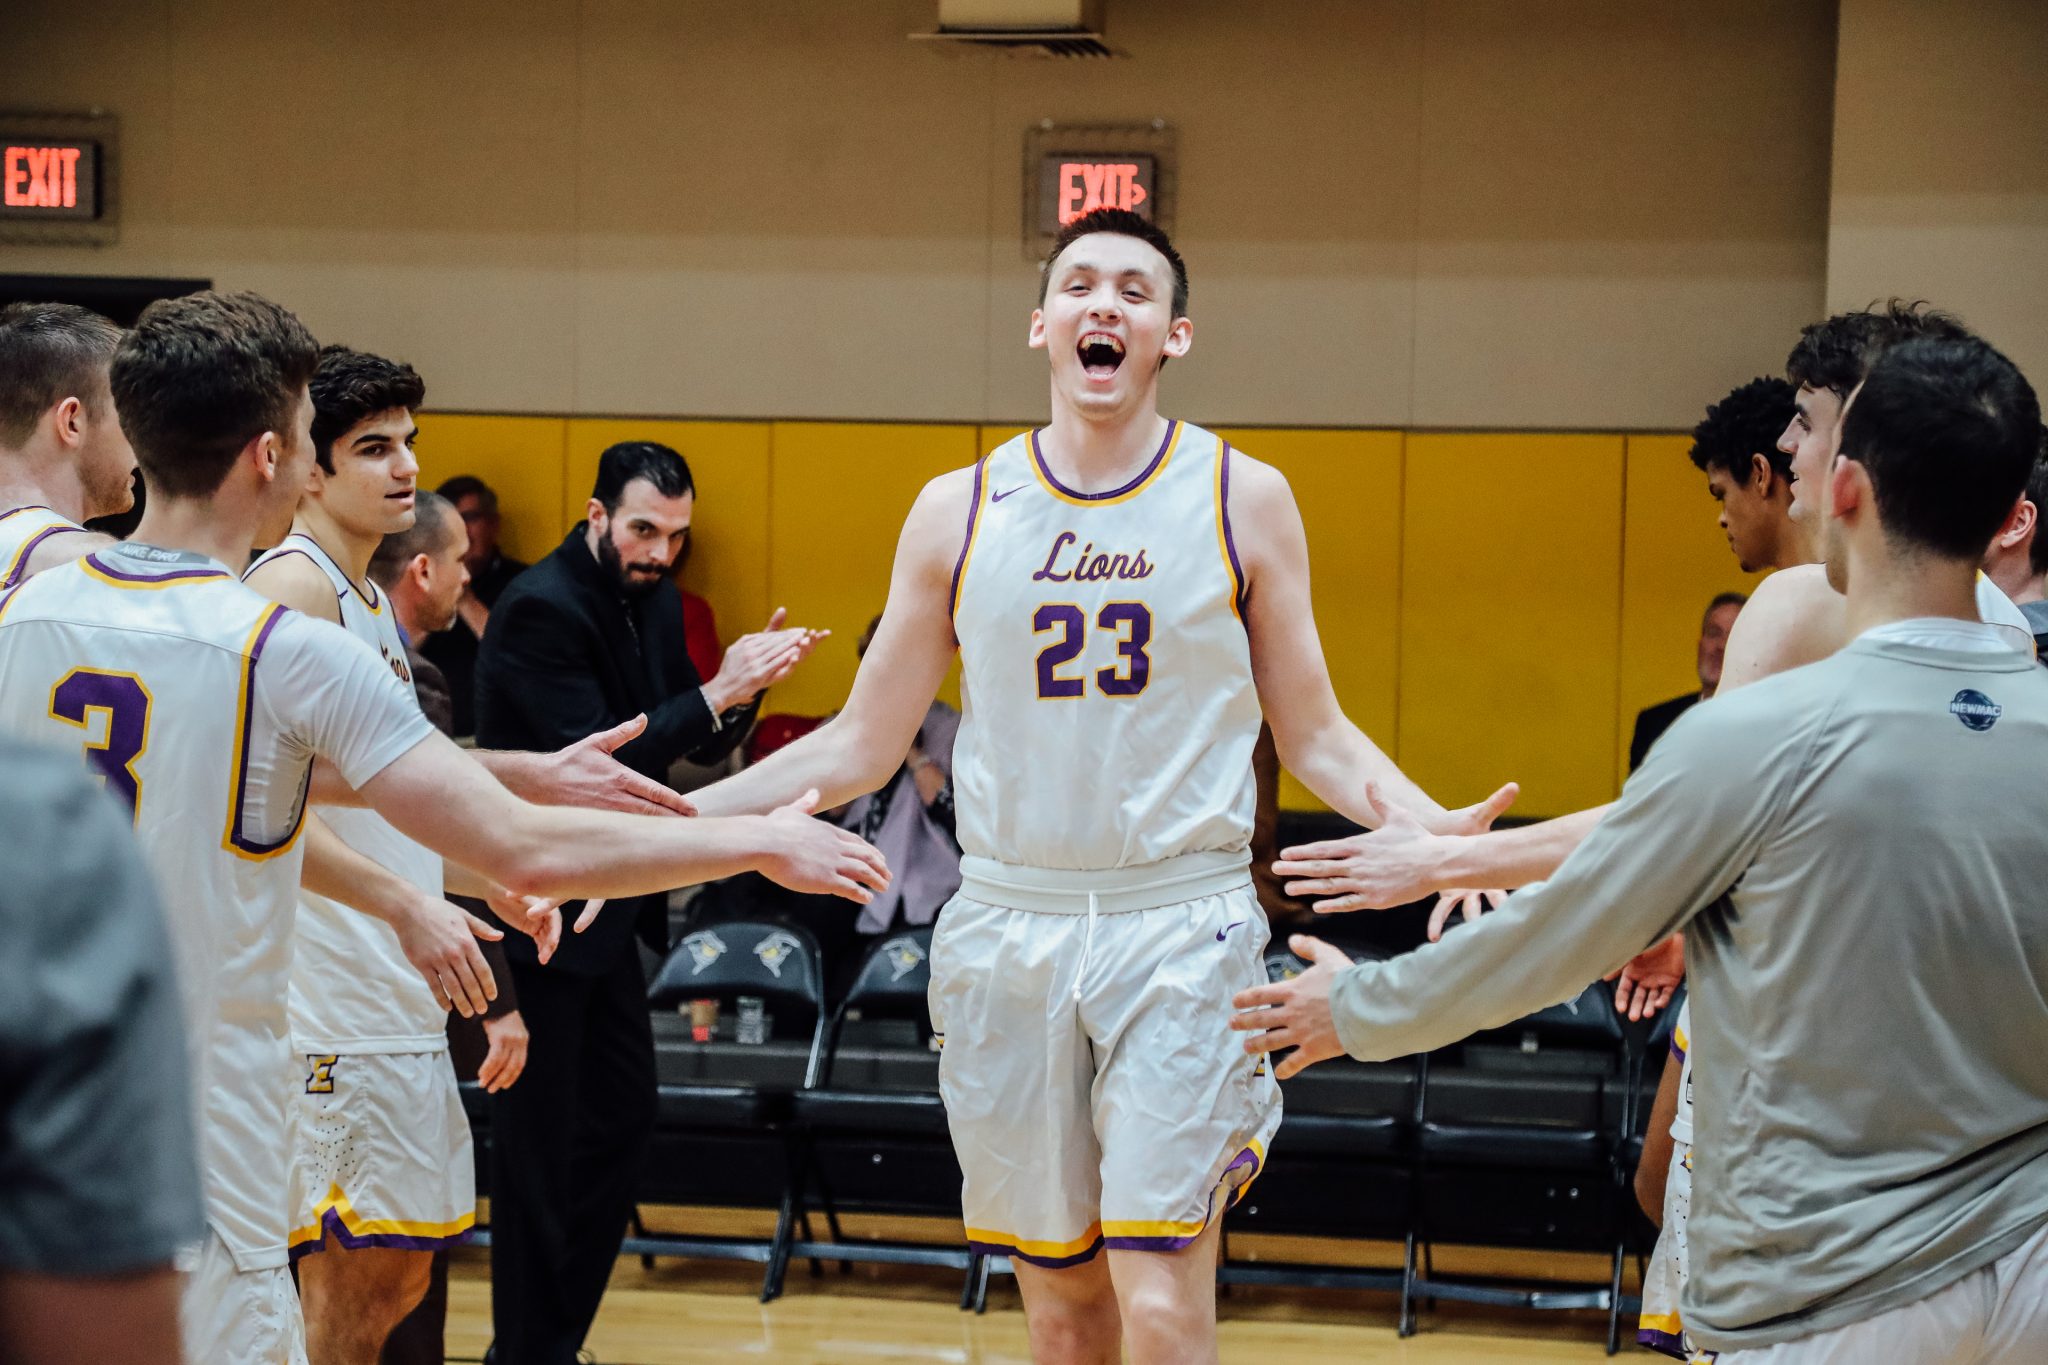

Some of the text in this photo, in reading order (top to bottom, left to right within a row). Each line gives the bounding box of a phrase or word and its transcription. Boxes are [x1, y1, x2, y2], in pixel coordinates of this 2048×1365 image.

[5, 147, 80, 208] EXIT
[1058, 163, 1139, 225] EXIT
[122, 544, 182, 563] NIKE PRO
[1032, 531, 1155, 583] Lions
[1031, 599, 1154, 702] 23
[1951, 702, 2001, 717] NEWMAC
[305, 1053, 339, 1094] E
